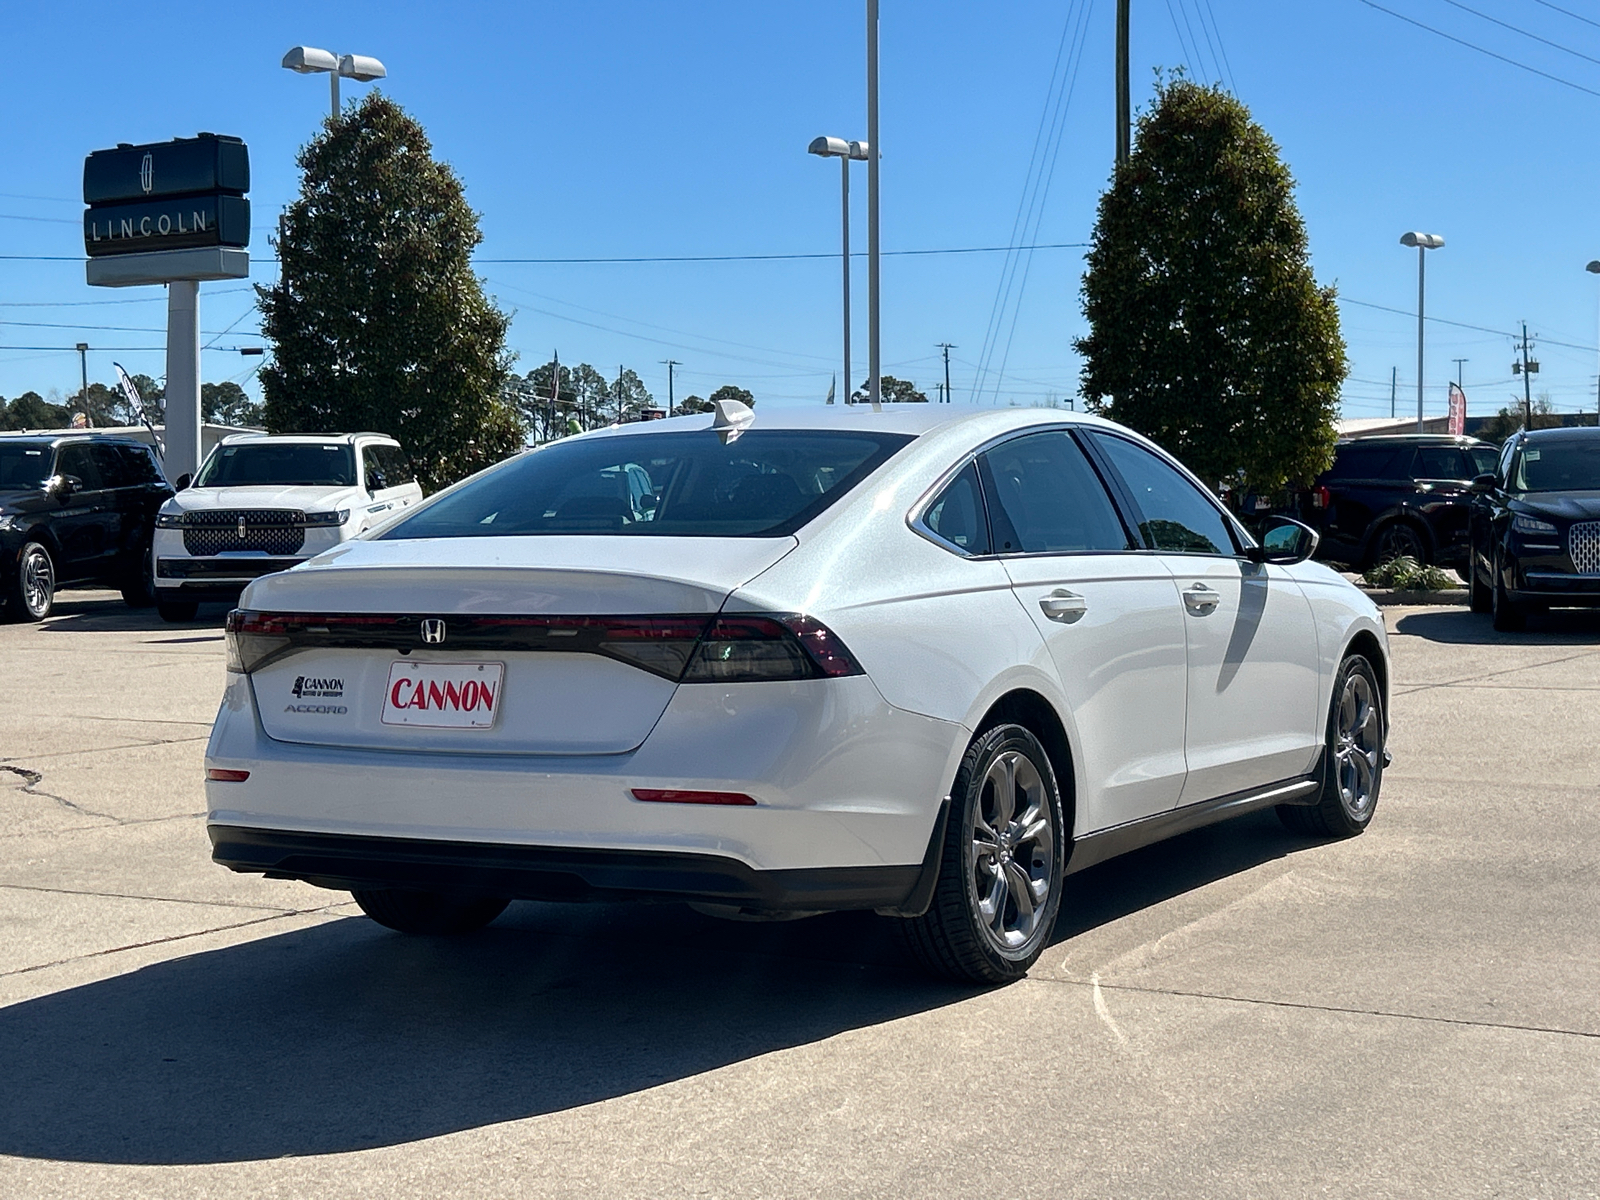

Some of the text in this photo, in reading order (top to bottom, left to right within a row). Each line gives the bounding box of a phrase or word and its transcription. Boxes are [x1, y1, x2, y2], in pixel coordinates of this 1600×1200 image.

[93, 210, 206, 241] LINCOLN
[304, 678, 345, 690] CANNON
[391, 678, 497, 712] CANNON
[284, 704, 348, 715] ACCORD
